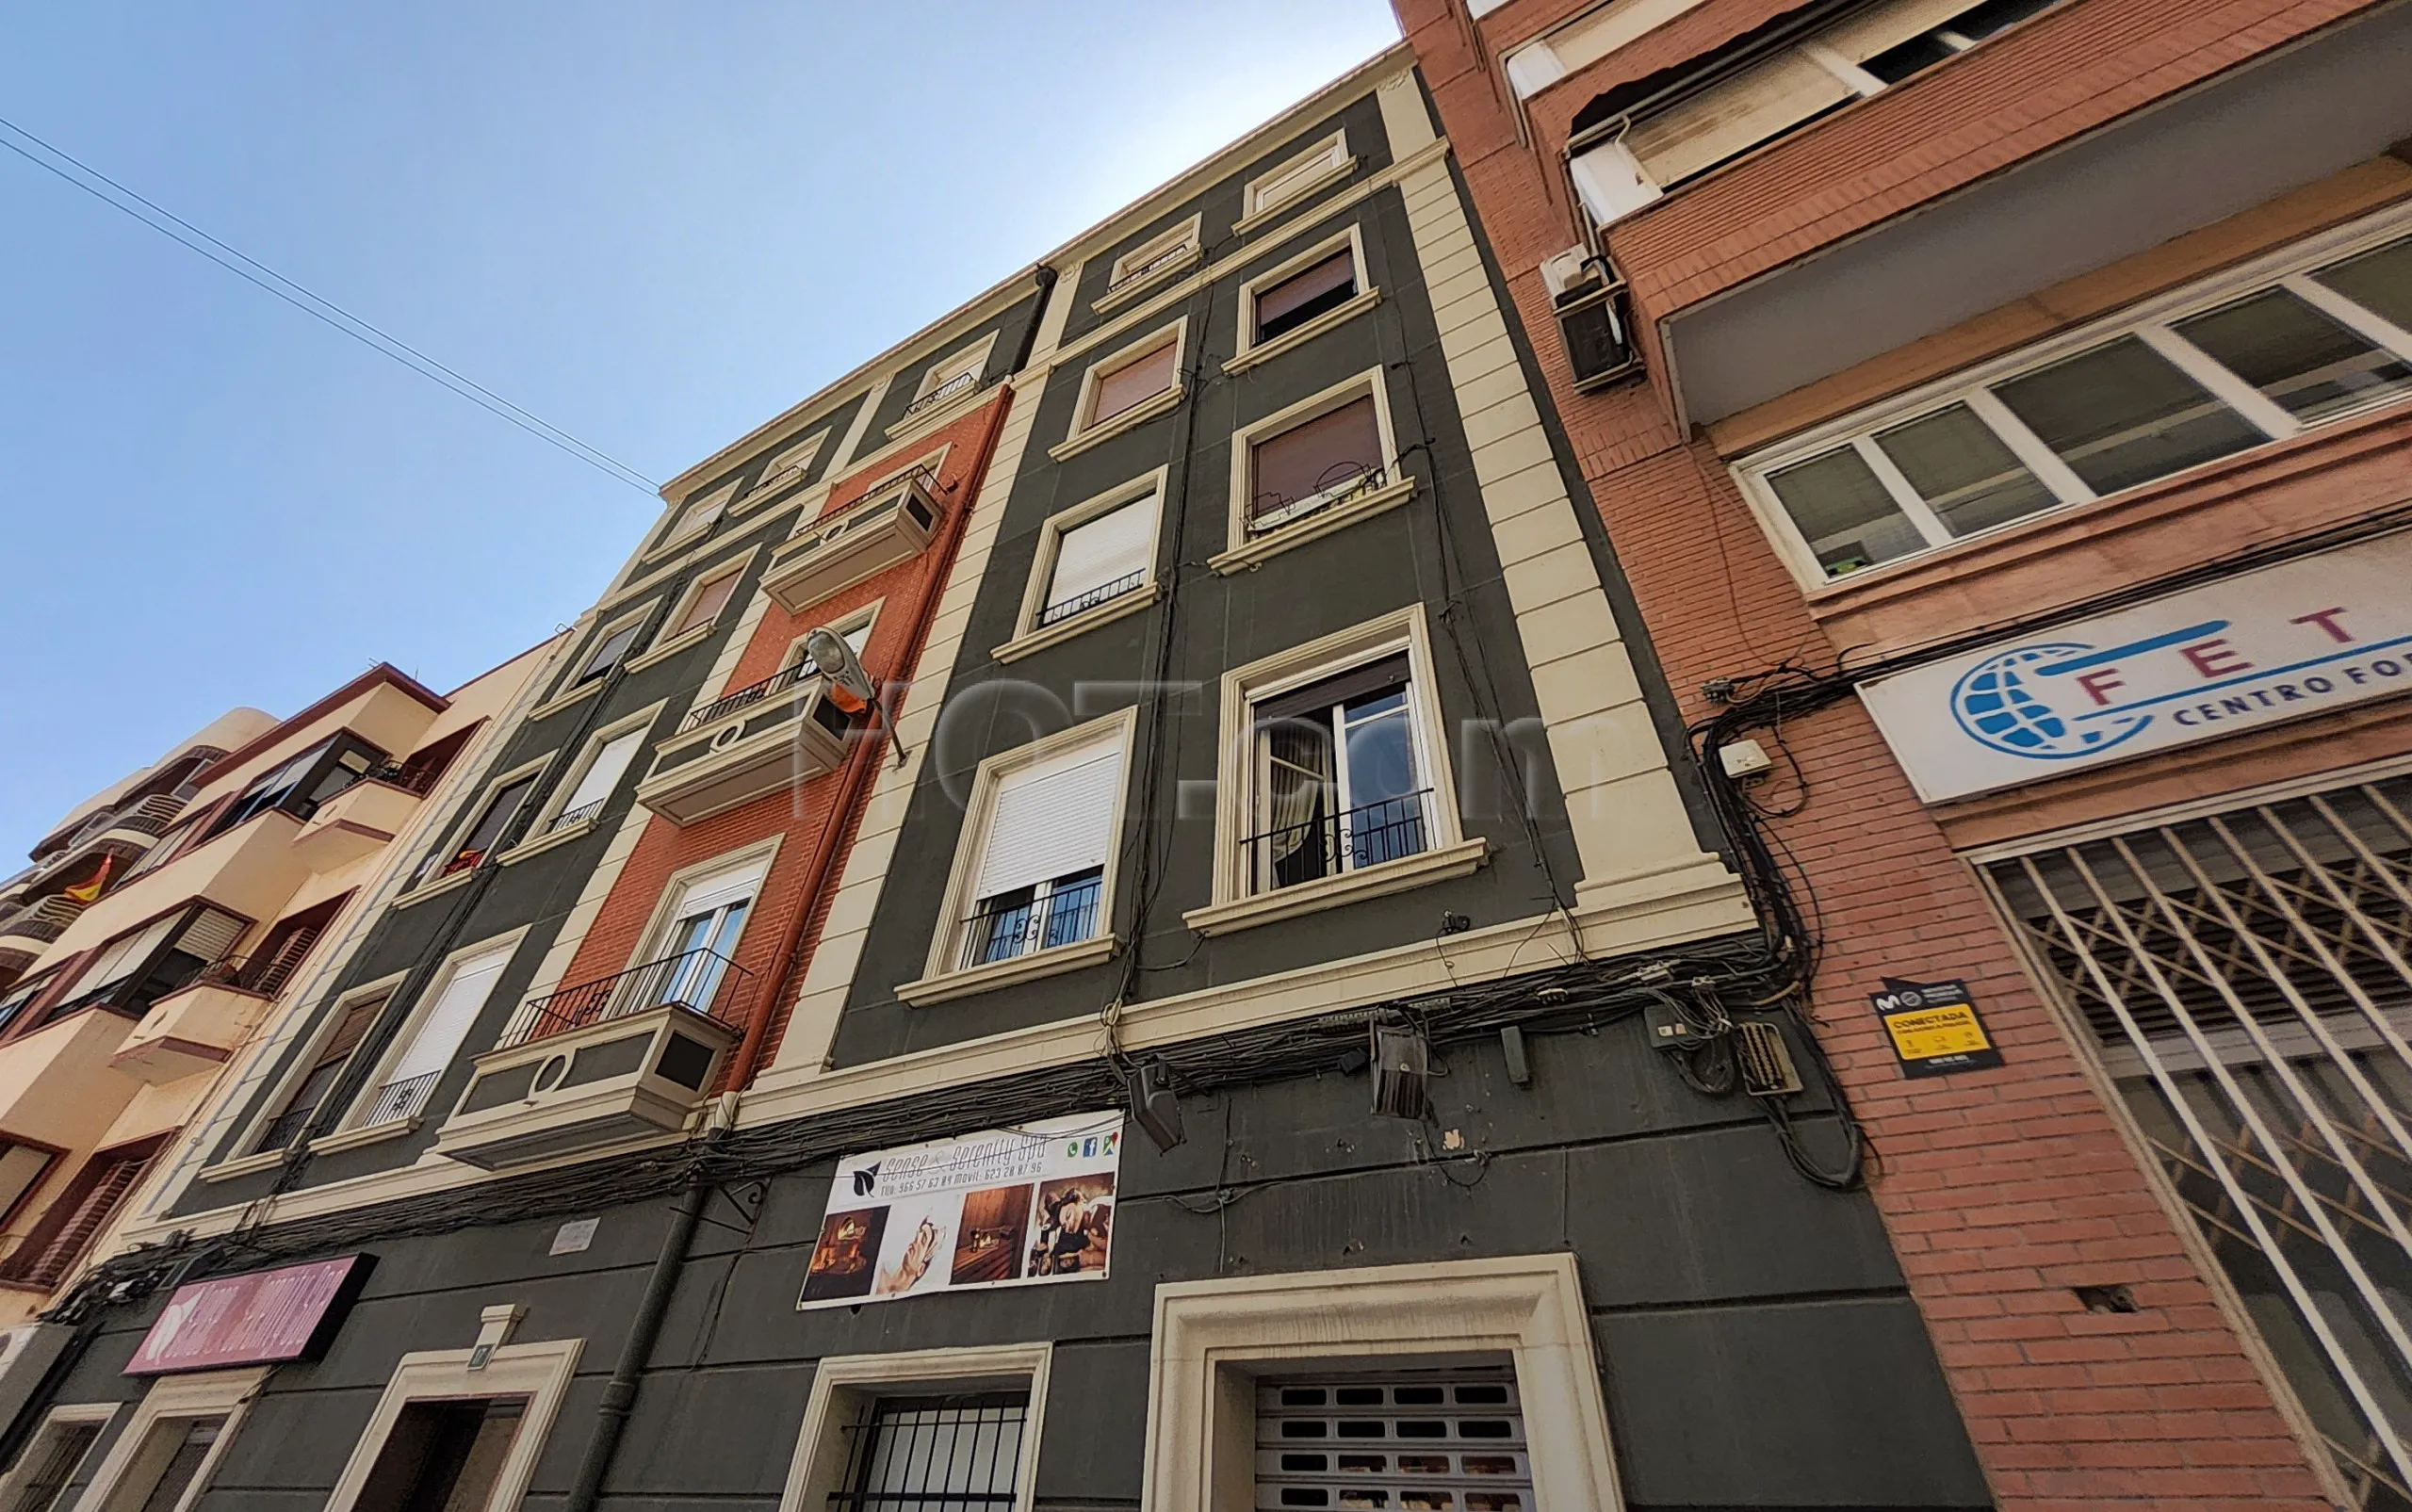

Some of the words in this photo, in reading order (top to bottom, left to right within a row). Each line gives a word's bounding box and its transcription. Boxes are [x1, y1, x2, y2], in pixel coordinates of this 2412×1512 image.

[2173, 676, 2334, 726] CENTRO
[1893, 1011, 1969, 1029] CONECTADA
[883, 1154, 928, 1183] Sense
[950, 1136, 1016, 1172] Serenity
